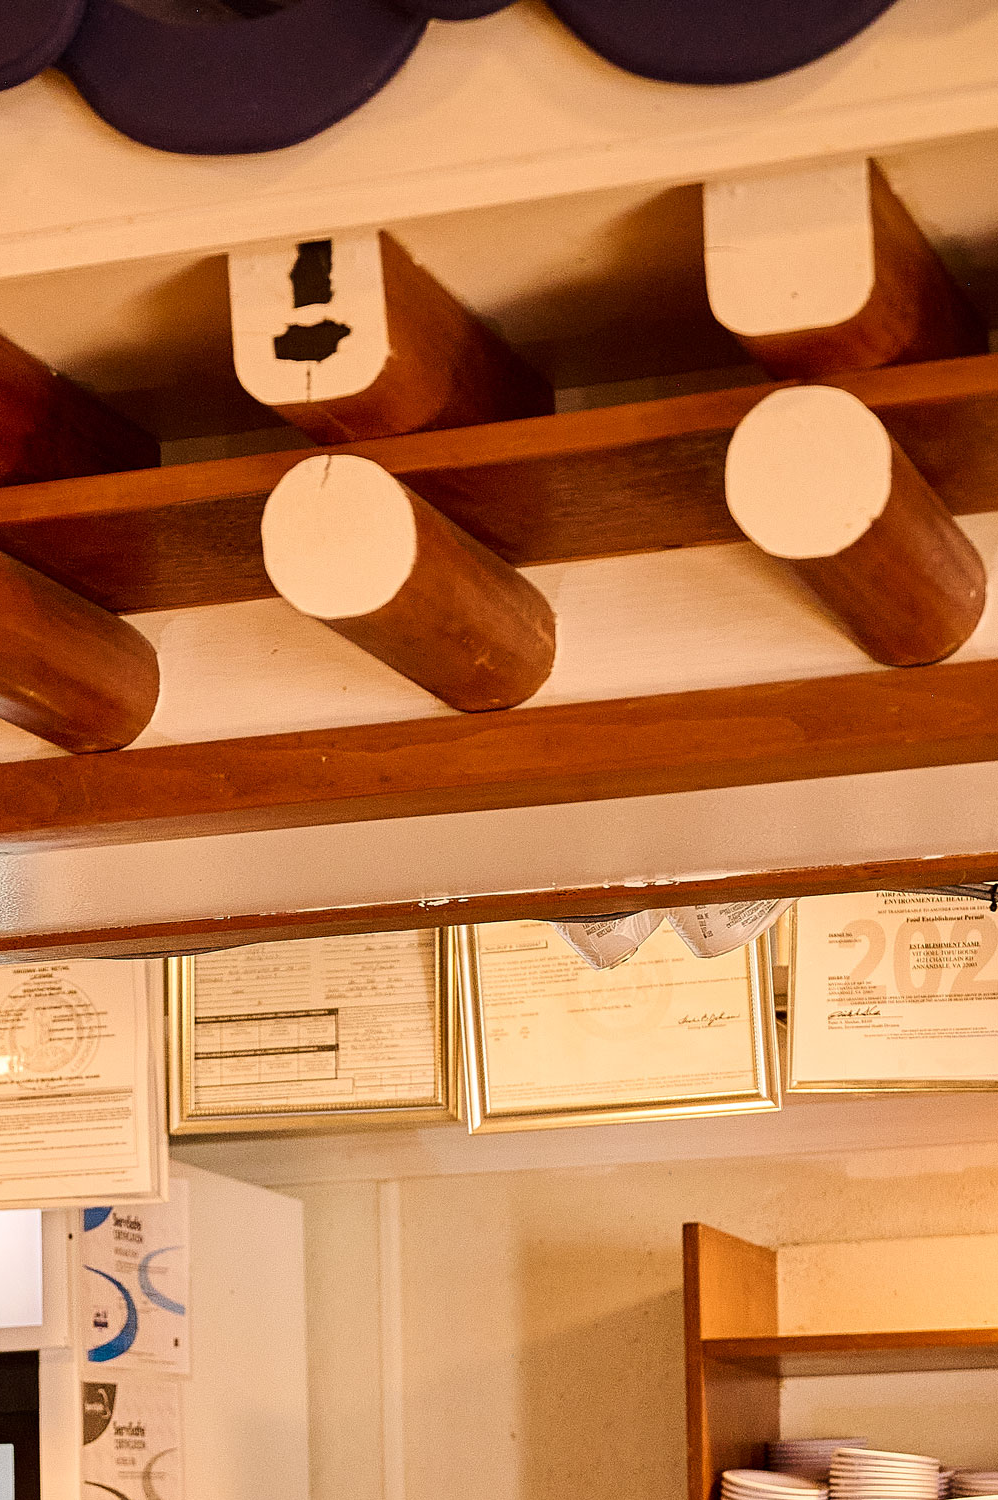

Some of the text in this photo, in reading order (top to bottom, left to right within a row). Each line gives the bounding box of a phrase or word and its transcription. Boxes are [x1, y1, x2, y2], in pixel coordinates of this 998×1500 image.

[884, 897, 943, 905] ENVIRONMENTAL
[922, 915, 963, 923] Establishment
[909, 942, 962, 950] ESTABLISHMENT
